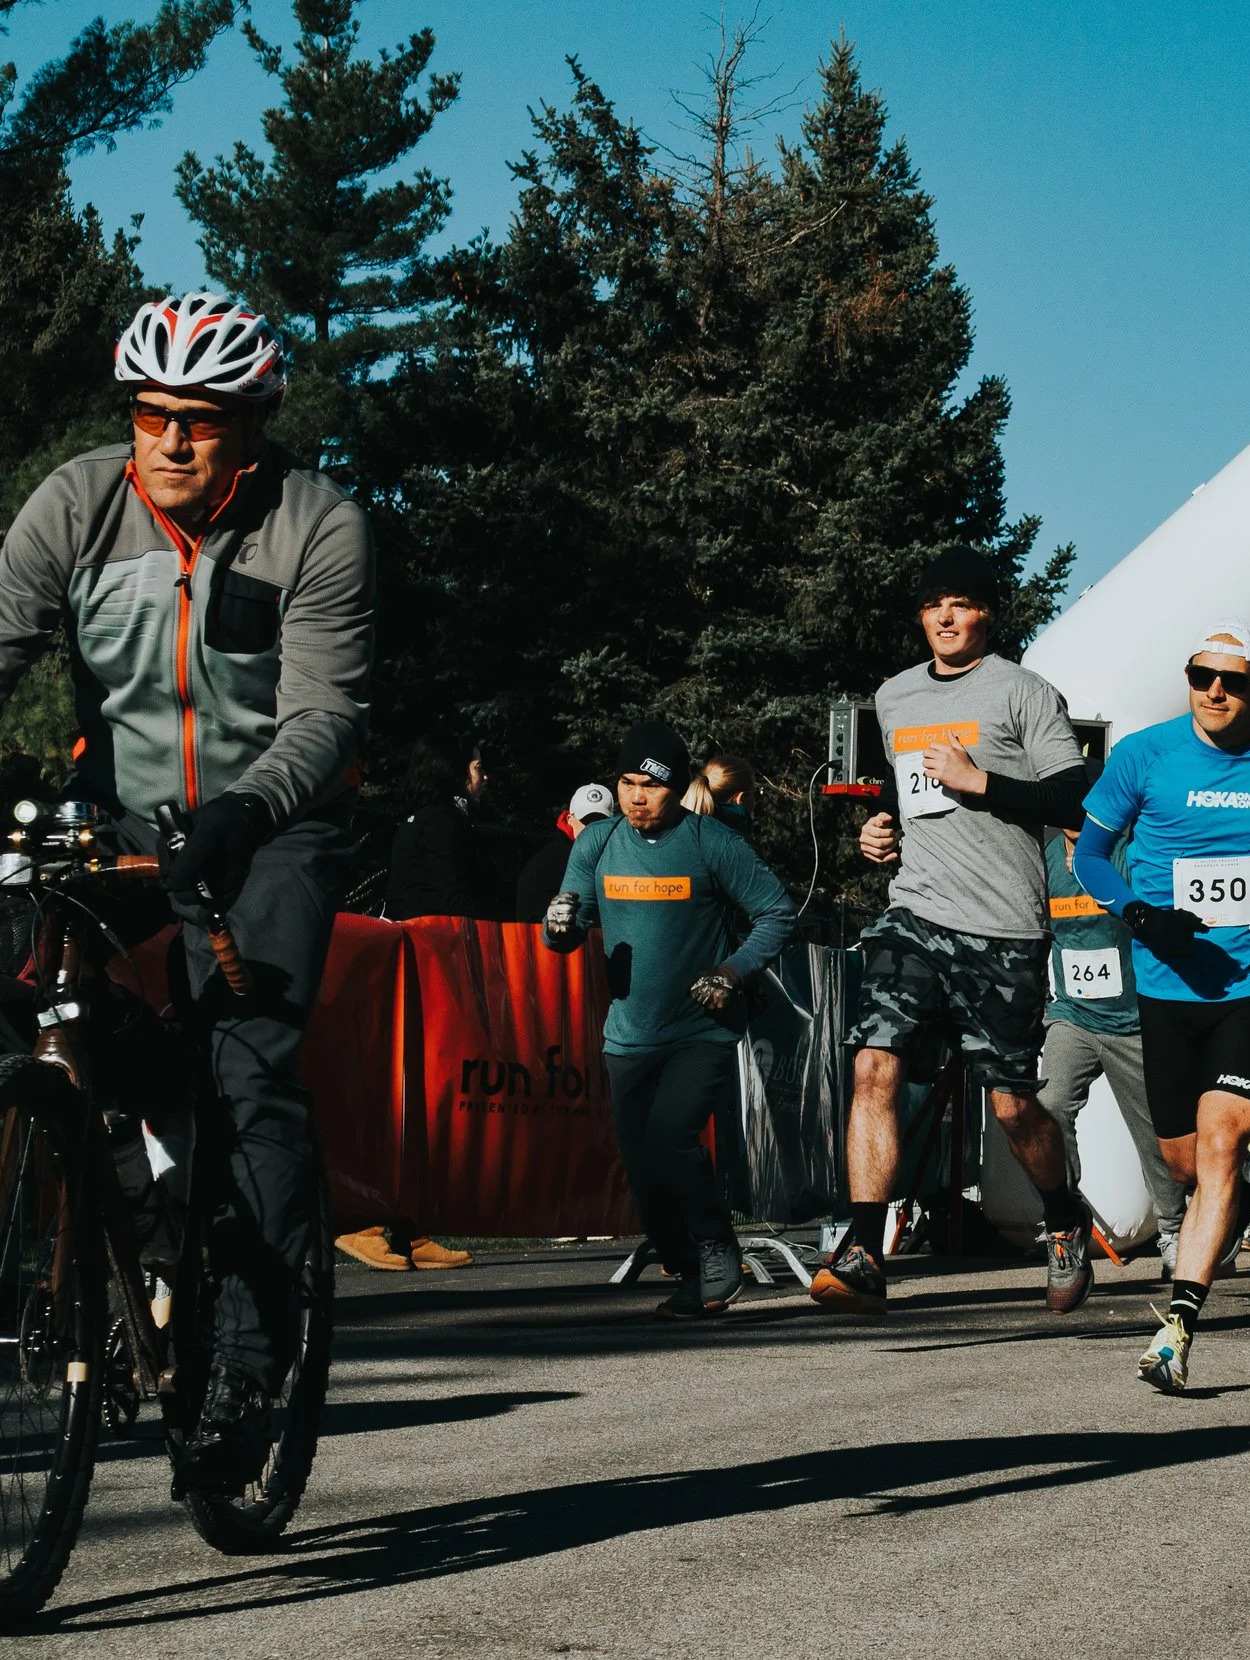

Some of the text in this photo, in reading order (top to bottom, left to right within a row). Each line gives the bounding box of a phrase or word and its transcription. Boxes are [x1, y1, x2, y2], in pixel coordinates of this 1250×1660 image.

[898, 735, 918, 745] run
[922, 730, 939, 743] for
[1186, 790, 1238, 809] HOKA
[609, 881, 684, 896] run for hope
[1189, 877, 1247, 903] 350
[1055, 903, 1071, 912] run
[1075, 899, 1090, 909] for
[1072, 963, 1110, 981] 264
[461, 1059, 531, 1097] run
